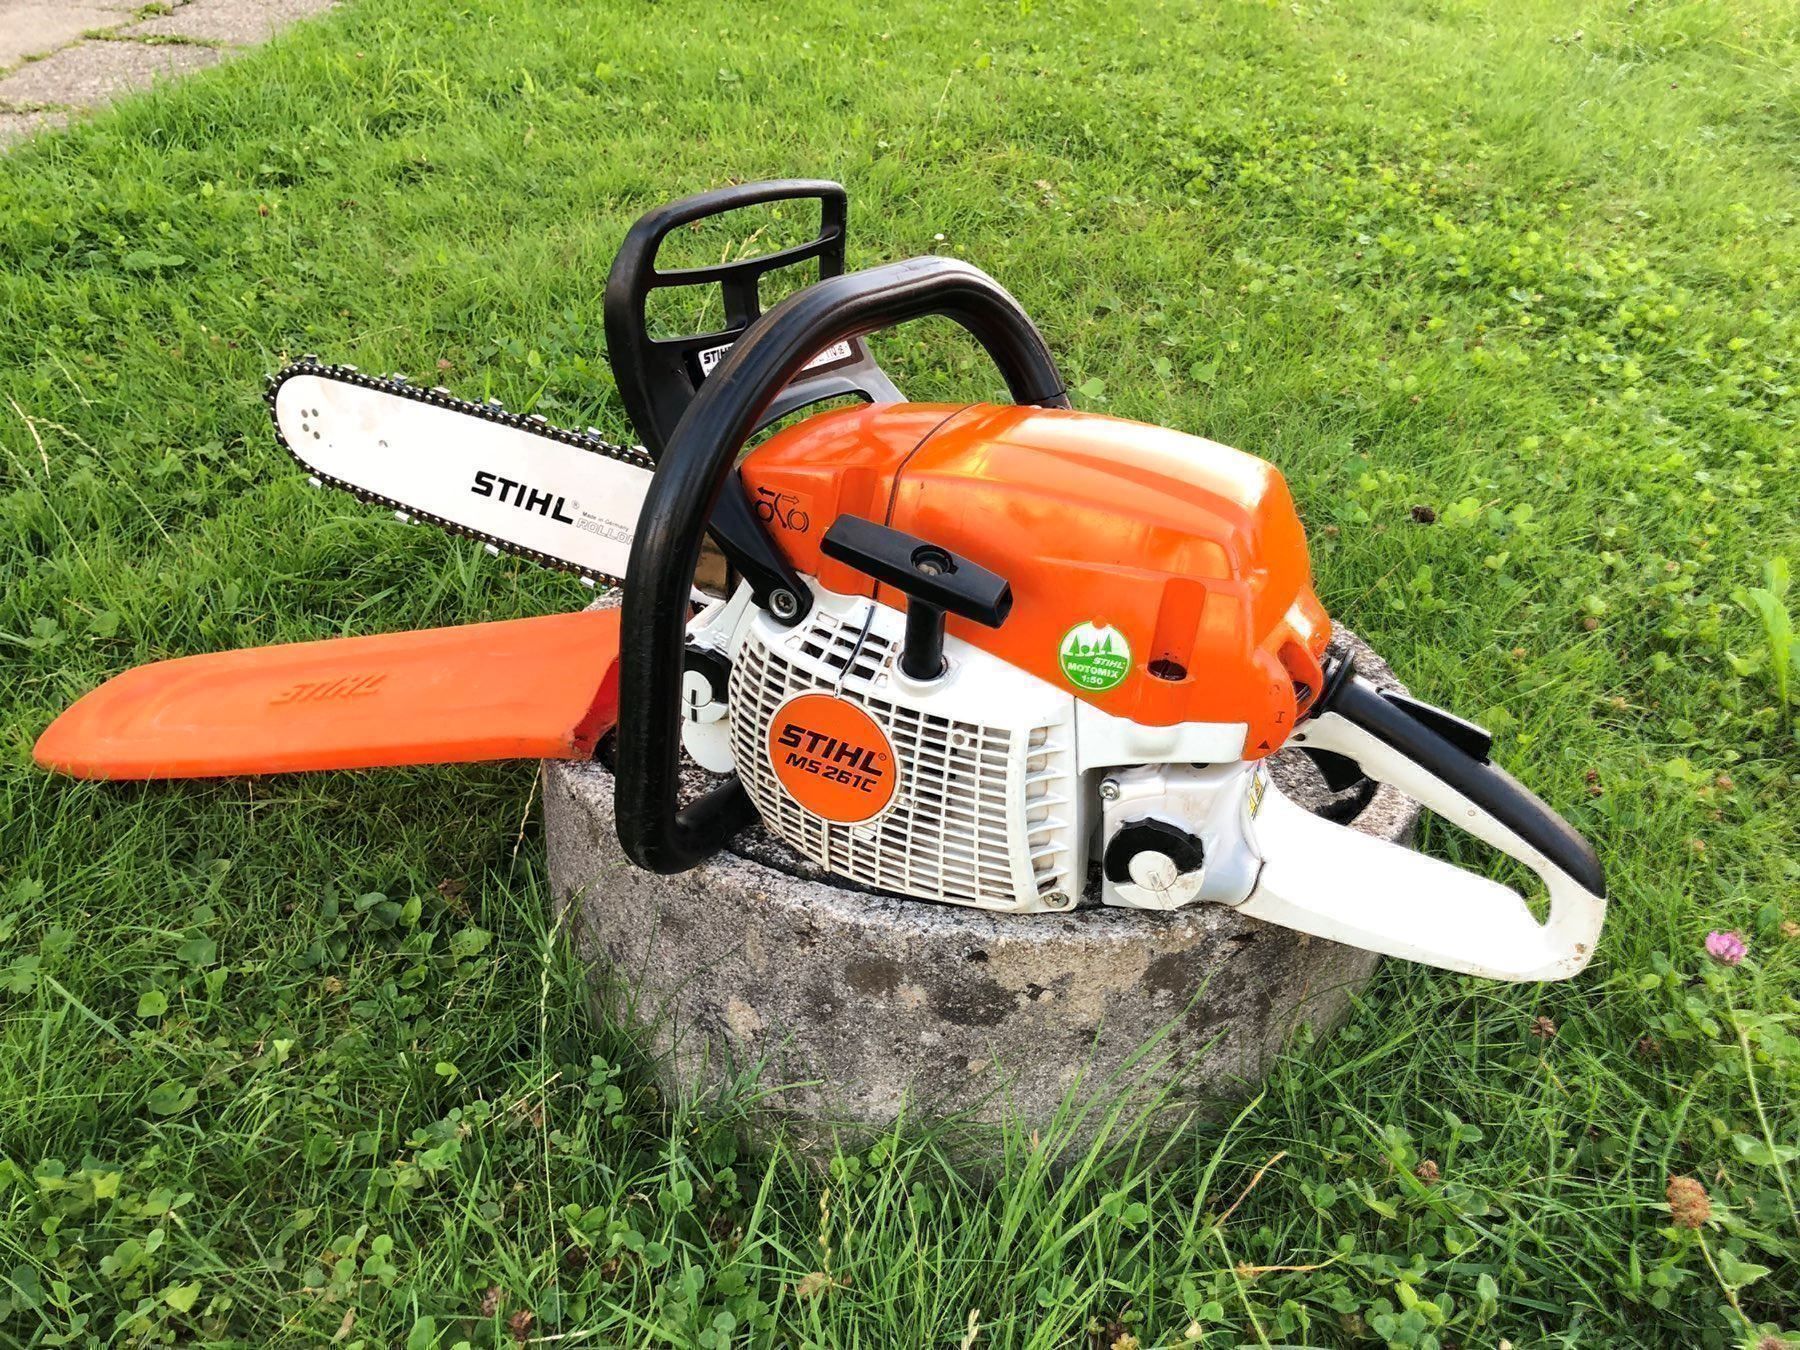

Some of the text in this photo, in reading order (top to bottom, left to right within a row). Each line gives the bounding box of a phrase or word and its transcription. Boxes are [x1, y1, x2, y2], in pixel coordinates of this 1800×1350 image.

[471, 470, 574, 525] STIHL
[1067, 662, 1119, 679] MOTOMIX
[1093, 657, 1124, 669] STIHL
[1081, 674, 1104, 685] 1:50
[777, 723, 883, 777] STIHL
[785, 752, 878, 793] MS 261C
